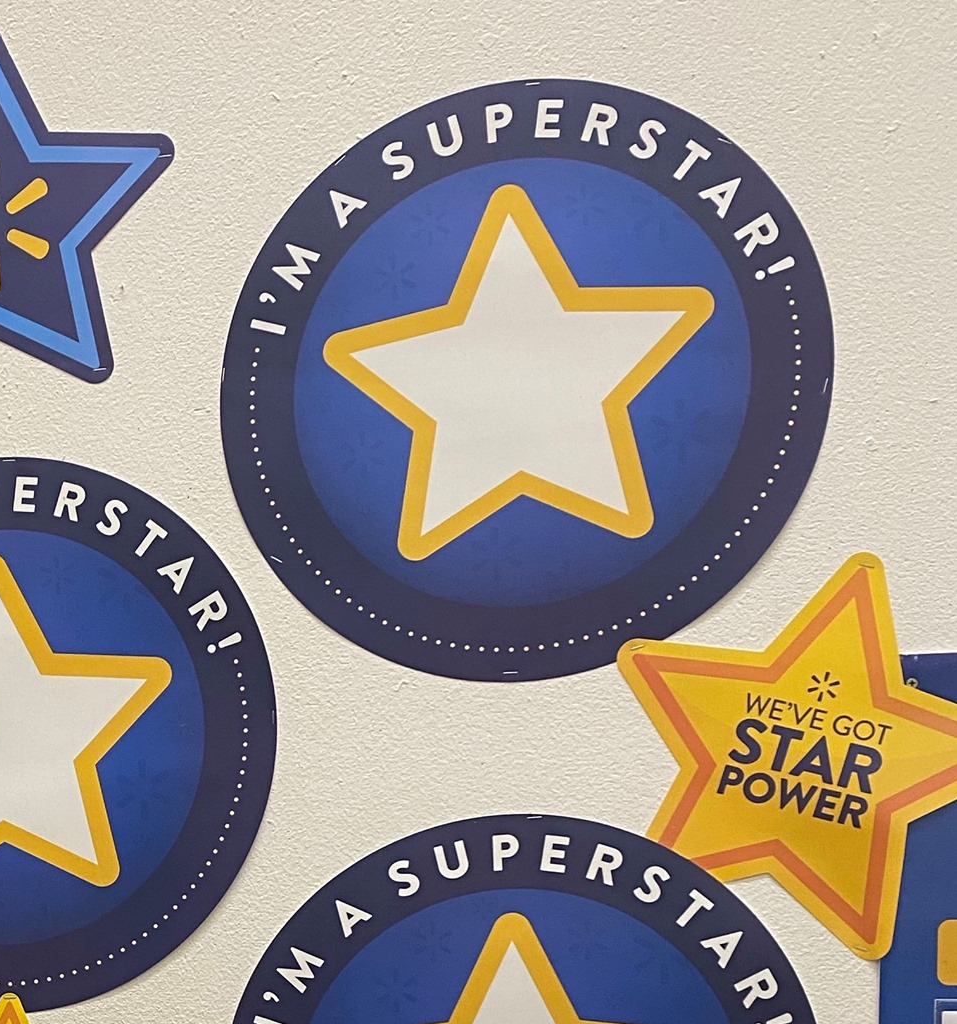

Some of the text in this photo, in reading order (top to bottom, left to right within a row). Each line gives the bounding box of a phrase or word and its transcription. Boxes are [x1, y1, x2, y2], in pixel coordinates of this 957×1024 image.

[249, 99, 796, 336] I'M A SUPERSTAR!
[746, 692, 892, 745] WE'VE GOT
[728, 718, 882, 794] STAR
[717, 765, 868, 828] POWER
[335, 899, 373, 938] A
